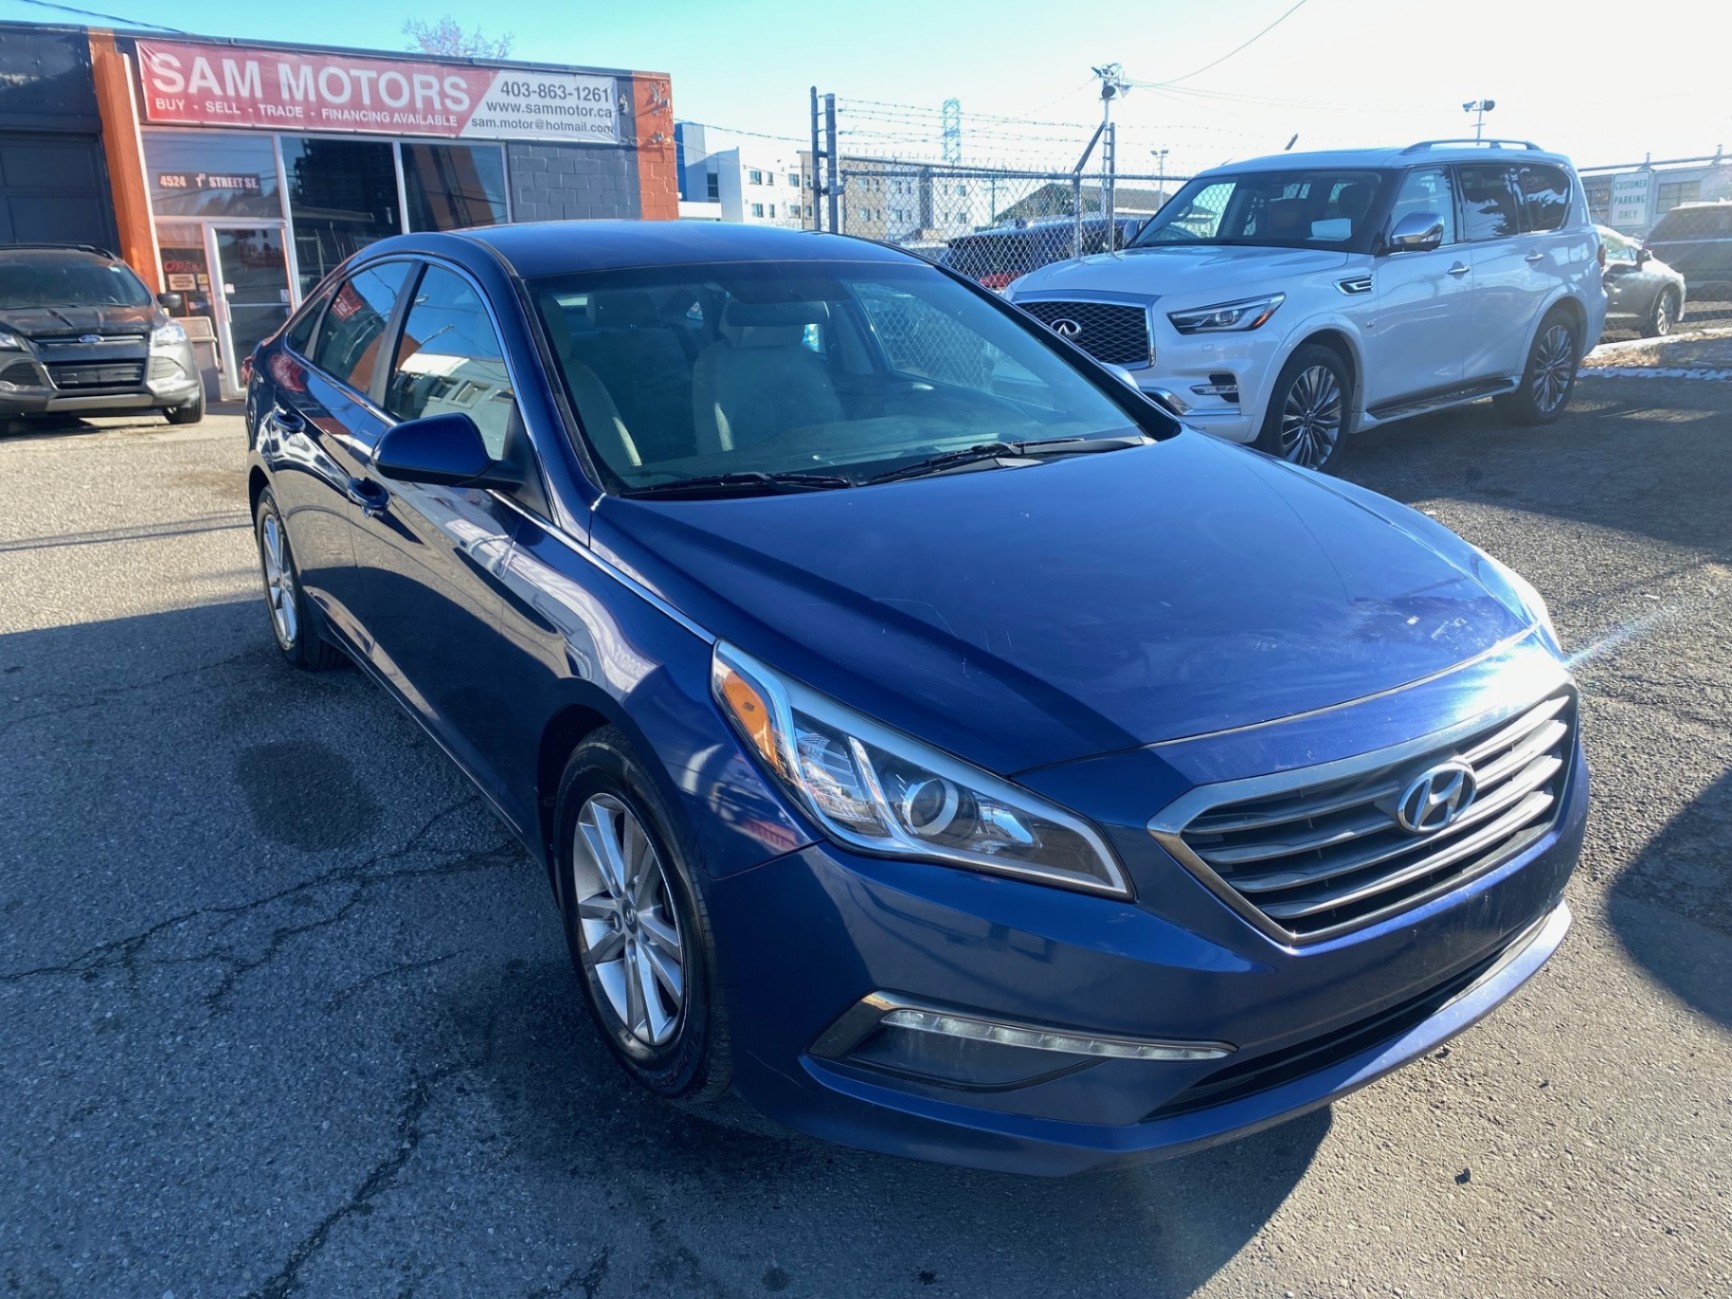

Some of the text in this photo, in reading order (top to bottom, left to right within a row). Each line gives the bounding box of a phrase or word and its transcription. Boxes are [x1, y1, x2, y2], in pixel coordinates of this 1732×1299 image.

[152, 52, 471, 112] SAM MOTORS
[501, 81, 610, 103] 403-863-1261
[155, 98, 186, 112] BUY
[205, 101, 241, 114] SELL
[258, 104, 304, 118] TRADE
[321, 107, 390, 123] FINANCING
[393, 111, 458, 127] AVAILABLE
[486, 101, 612, 118] www.sammotor.ca
[471, 118, 614, 133] sam.motor@hotmail.com
[160, 175, 187, 188] 4524
[208, 176, 243, 189] STREET
[1614, 194, 1646, 205] PARKING
[1618, 210, 1639, 220] ONLY
